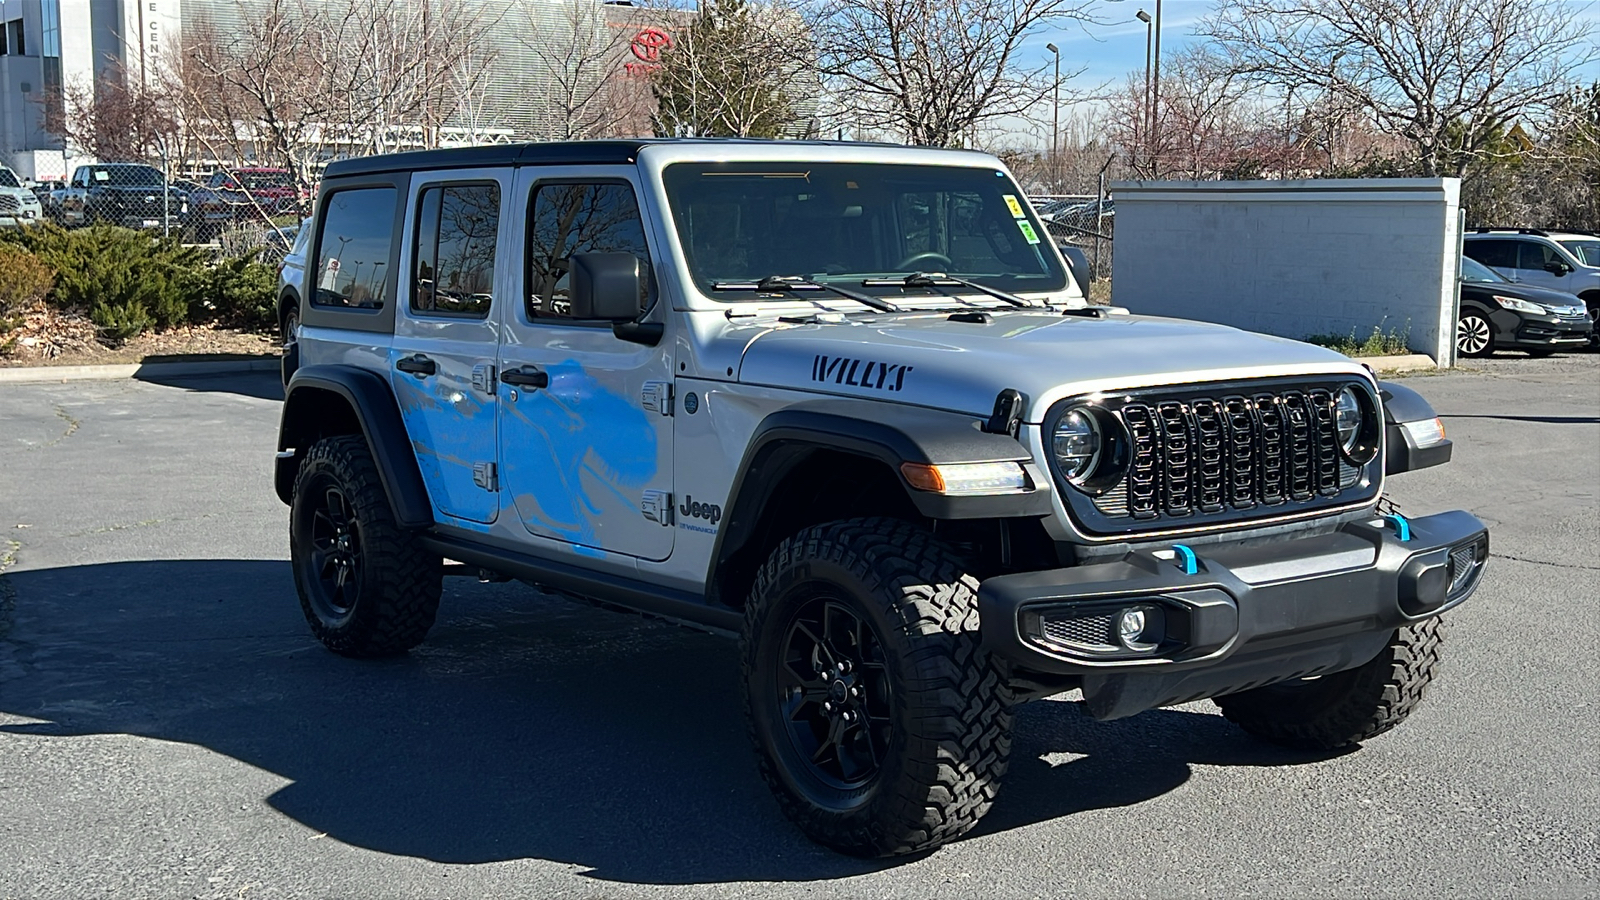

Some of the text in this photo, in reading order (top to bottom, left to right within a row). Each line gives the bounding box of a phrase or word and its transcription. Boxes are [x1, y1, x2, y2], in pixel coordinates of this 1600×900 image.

[149, 21, 161, 88] CENTER
[812, 354, 914, 392] WILLYS
[679, 494, 722, 526] Jeep
